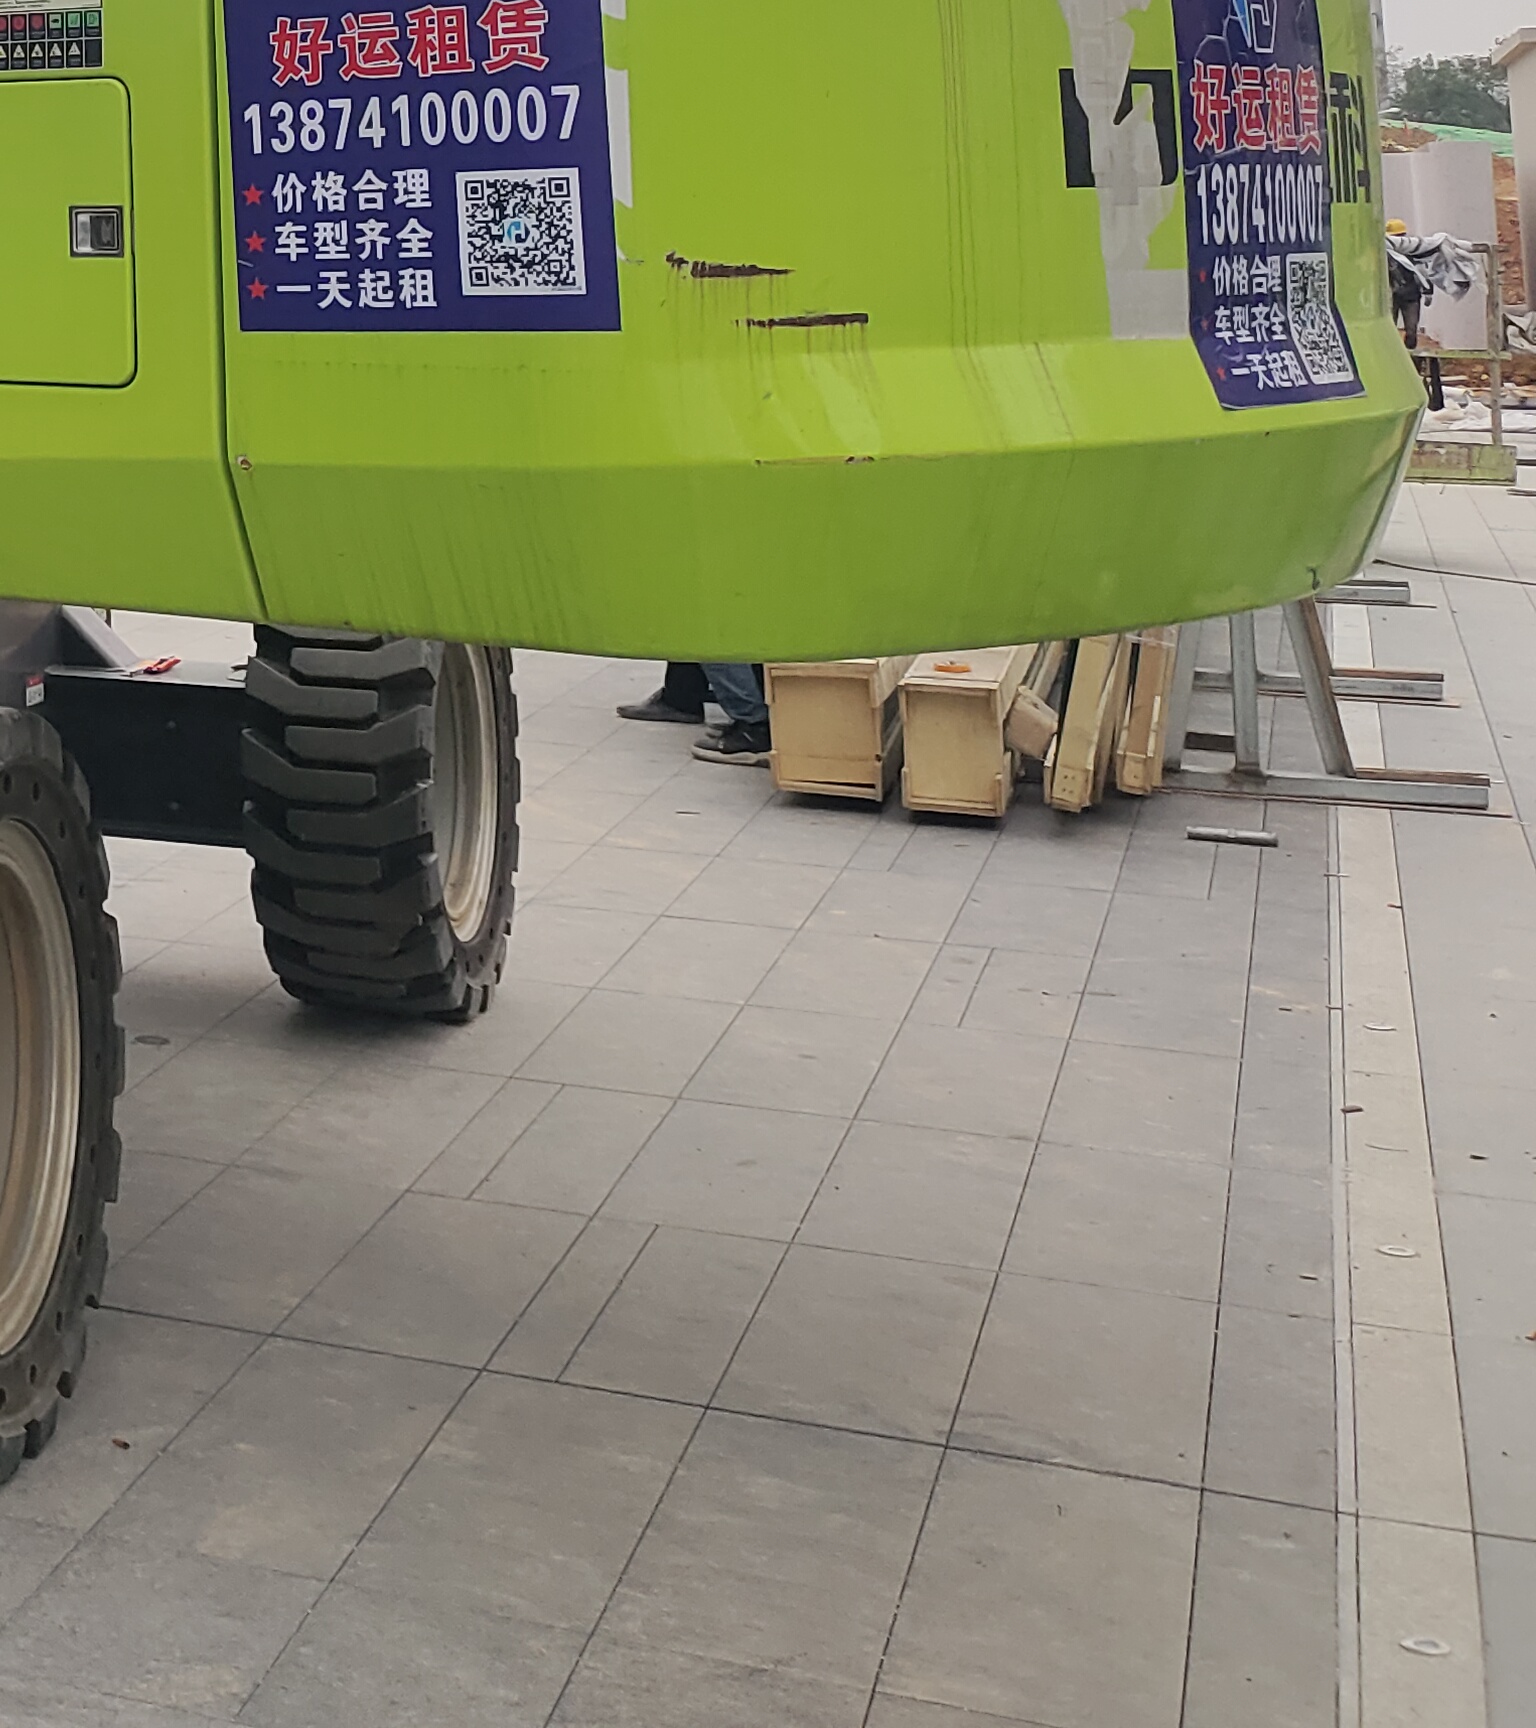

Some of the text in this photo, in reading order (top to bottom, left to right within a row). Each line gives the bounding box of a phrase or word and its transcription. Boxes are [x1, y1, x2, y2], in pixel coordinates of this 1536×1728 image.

[243, 84, 581, 155] 13874100007
[1189, 60, 1323, 154] 好运租赁
[271, 169, 433, 214] 价格合理
[1197, 162, 1325, 246] 13874100007
[274, 218, 434, 262] 车型齐全
[275, 268, 438, 309] 一天起租
[1212, 255, 1282, 297] 价格合理
[1214, 305, 1288, 345] 车型齐全
[1231, 350, 1309, 390] 一天起租
